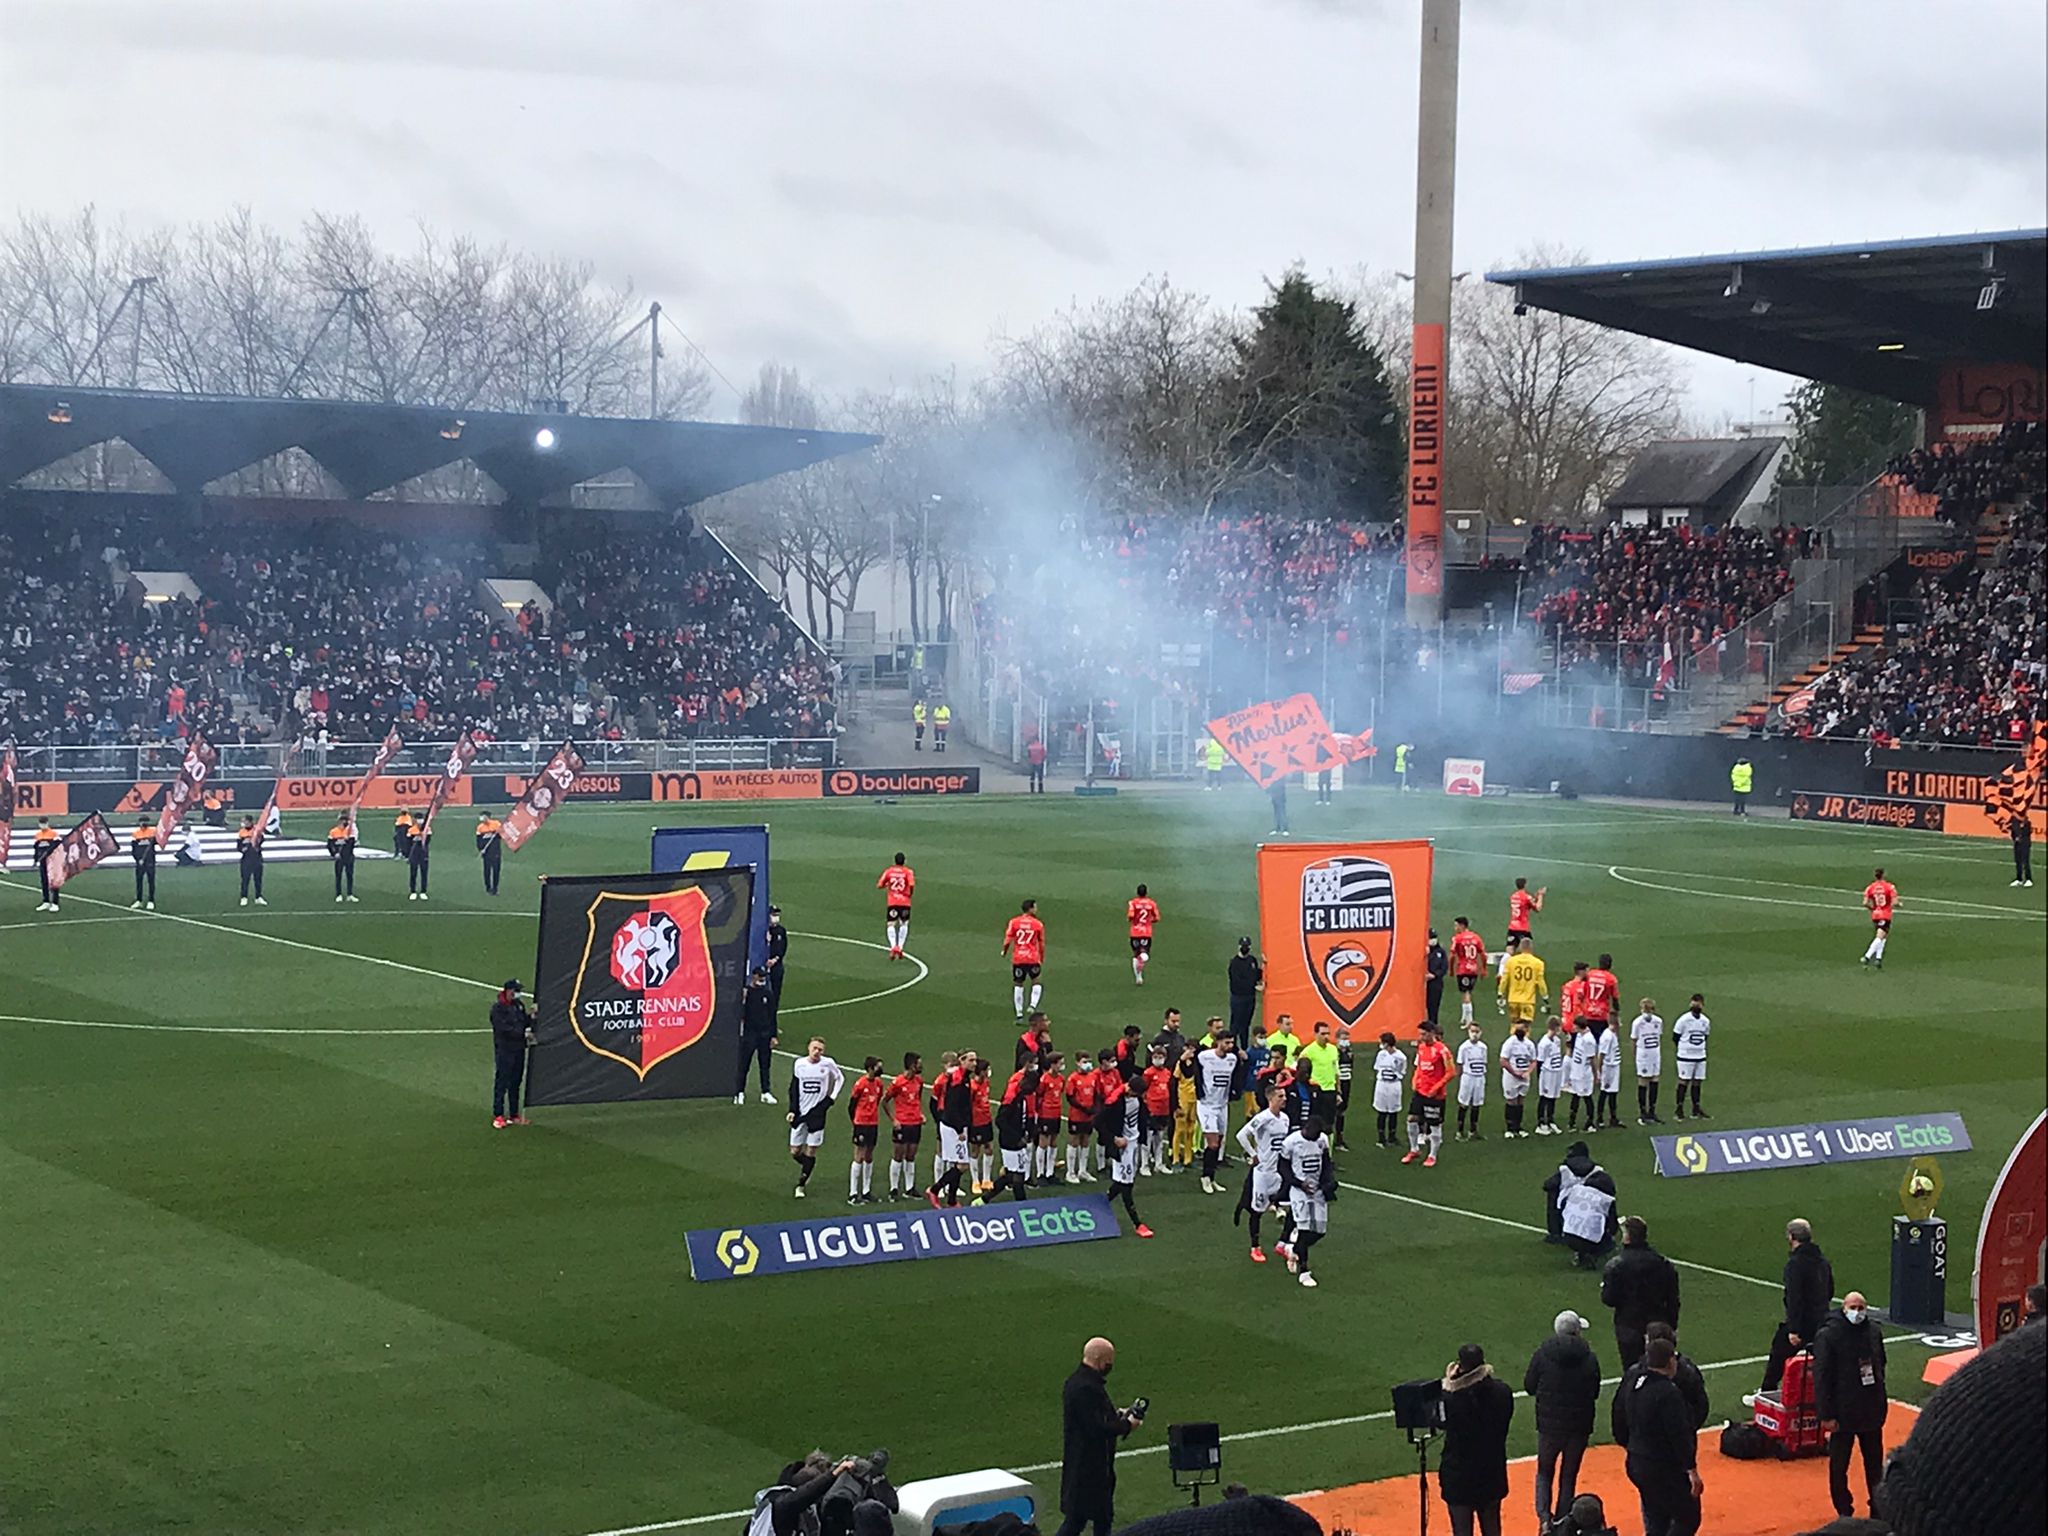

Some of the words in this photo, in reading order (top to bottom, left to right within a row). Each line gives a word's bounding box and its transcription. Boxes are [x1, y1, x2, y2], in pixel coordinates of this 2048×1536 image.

[1412, 363, 1438, 466] LORIENT
[1412, 476, 1437, 507] FC
[548, 759, 574, 789] 23
[713, 774, 733, 786] MA
[735, 772, 774, 786] PIÈCES
[777, 773, 818, 785] AUTOS
[861, 772, 970, 794] boulanger
[1886, 770, 1909, 796] FC
[1914, 772, 1986, 800] LORIENT
[288, 779, 358, 797] GUYOT
[1817, 797, 1845, 818] JR
[1847, 798, 1916, 828] Carrelage
[889, 877, 906, 891] 23
[1138, 909, 1148, 923] 2
[1305, 908, 1326, 931] FC
[1329, 906, 1392, 930] LORIENT
[1015, 929, 1035, 945] 27
[1464, 943, 1477, 959] 10
[1513, 966, 1533, 981] 30
[1589, 983, 1605, 1000] 17
[584, 999, 633, 1018] STADE
[636, 996, 702, 1014] RENNAIS
[602, 1019, 654, 1031] FOOTBALL
[658, 1016, 685, 1028] CLUB
[1719, 1132, 1814, 1165] LIGUE
[1815, 1133, 1832, 1157] 1
[1835, 1127, 1895, 1154] Uber
[1896, 1123, 1954, 1150] Eats
[779, 1220, 904, 1263] LIGUE
[909, 1219, 931, 1250] 1
[940, 1215, 1017, 1247] Uber
[1018, 1206, 1096, 1238] Eats
[1933, 1225, 1947, 1280] GOAT
